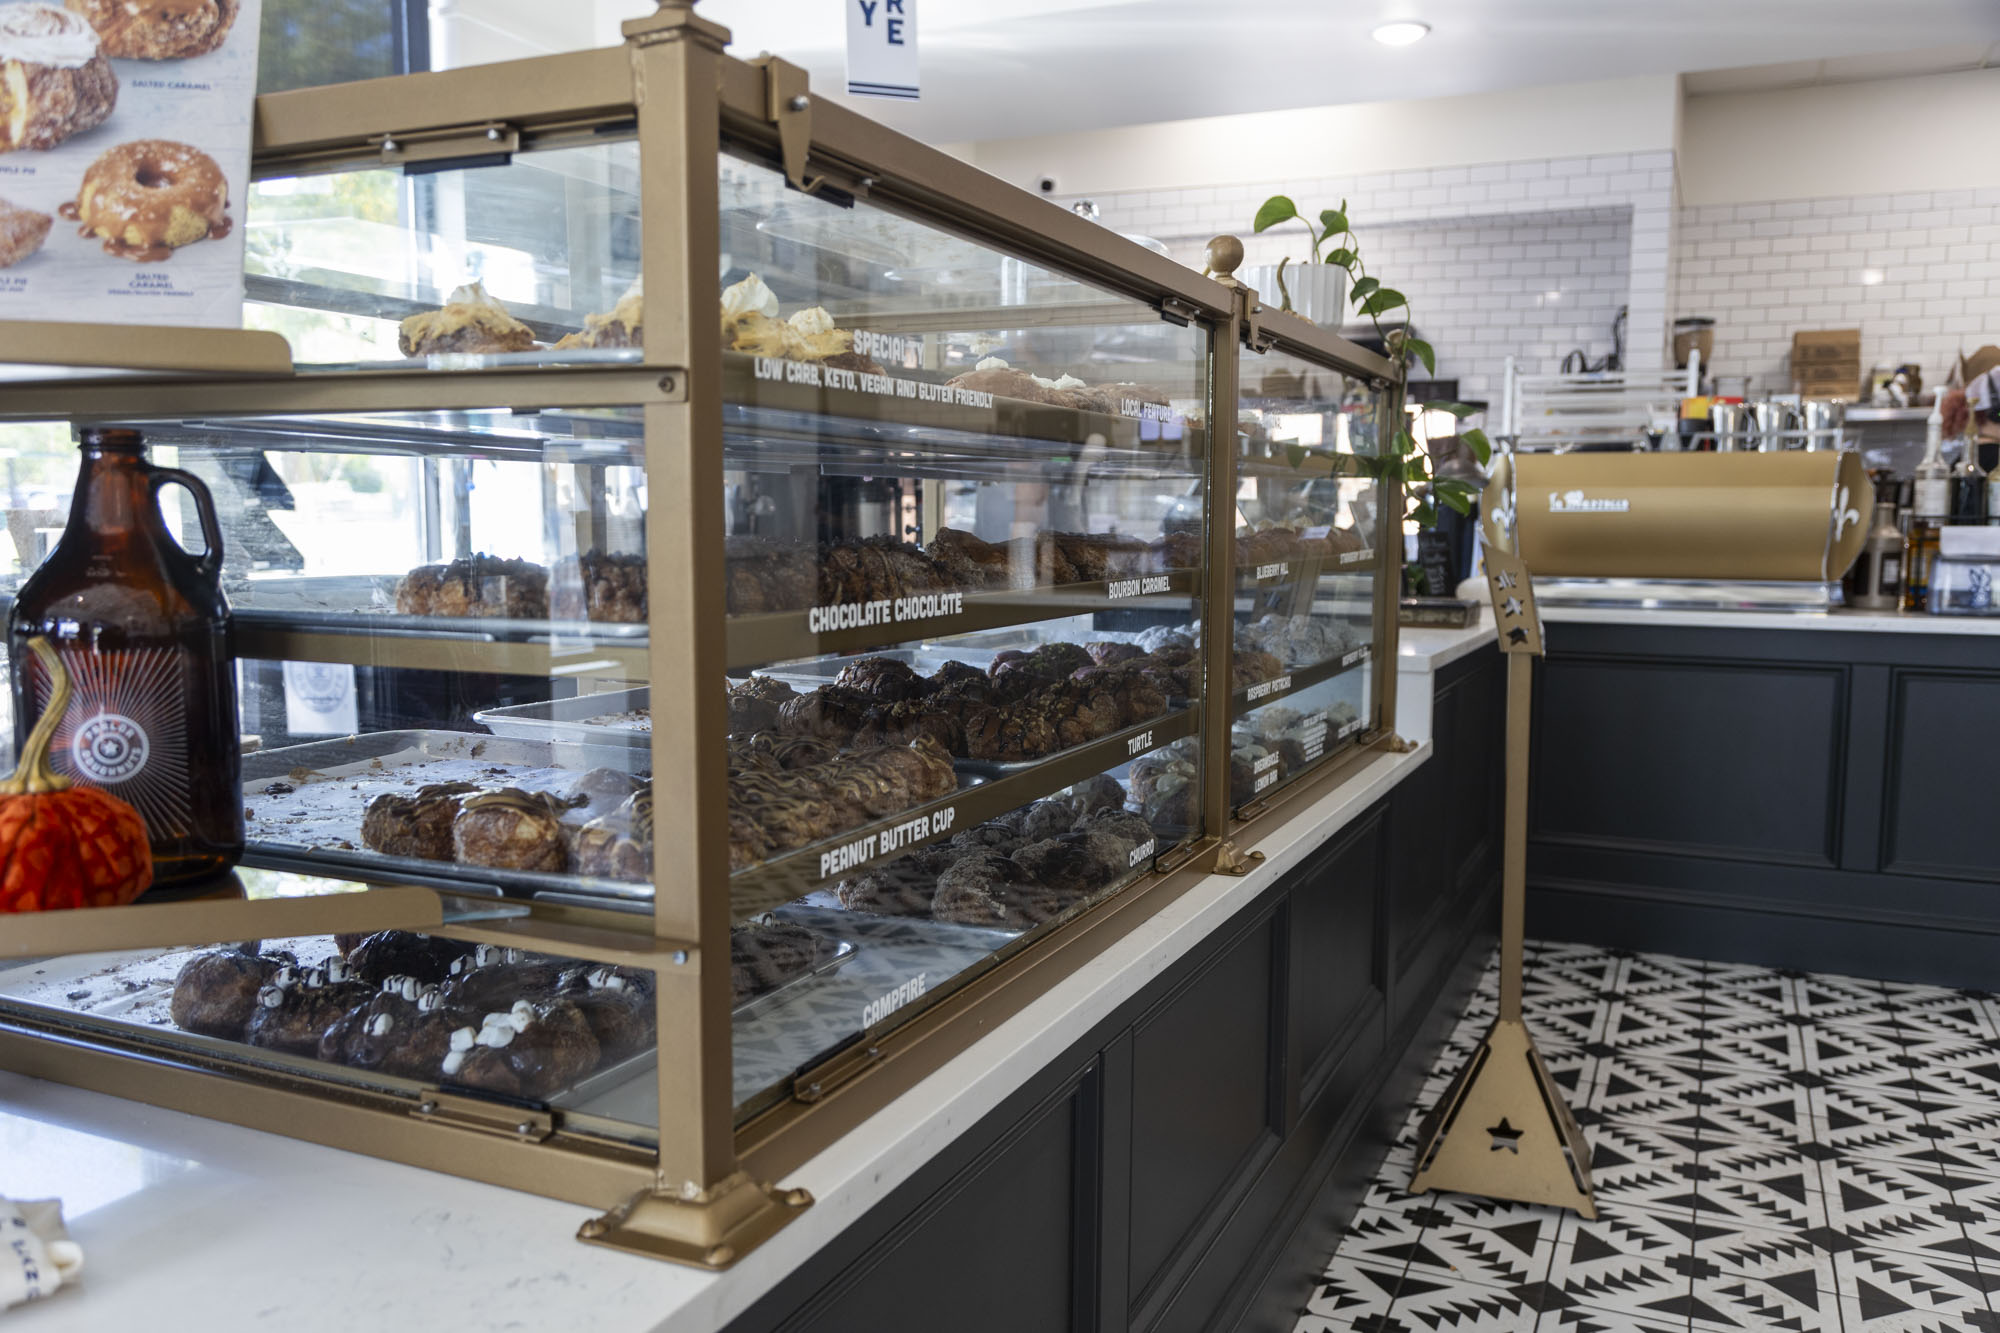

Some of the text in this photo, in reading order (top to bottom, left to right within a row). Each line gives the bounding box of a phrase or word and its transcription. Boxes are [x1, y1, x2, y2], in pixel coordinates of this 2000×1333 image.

[129, 281, 174, 289] CARAMEL
[853, 328, 925, 366] SPECIALTY
[754, 357, 993, 409] LOW CARB, KETO, VEGAN AND GLUTEN FRIENDLY
[1121, 397, 1143, 418] LOCAL
[1256, 563, 1280, 580] BLUEBERRY
[1108, 575, 1171, 600] BOURBON CARAMEL
[809, 592, 963, 633] CHOCOLATE CHOCOLATE
[1247, 675, 1292, 702] RASPBERRY PISTACHIO
[1127, 730, 1153, 756] TURTLE
[821, 806, 955, 879] PEANUT BUTTER CUP
[1129, 838, 1155, 868] CHURRO
[863, 972, 926, 1029] CAMPFIRE
